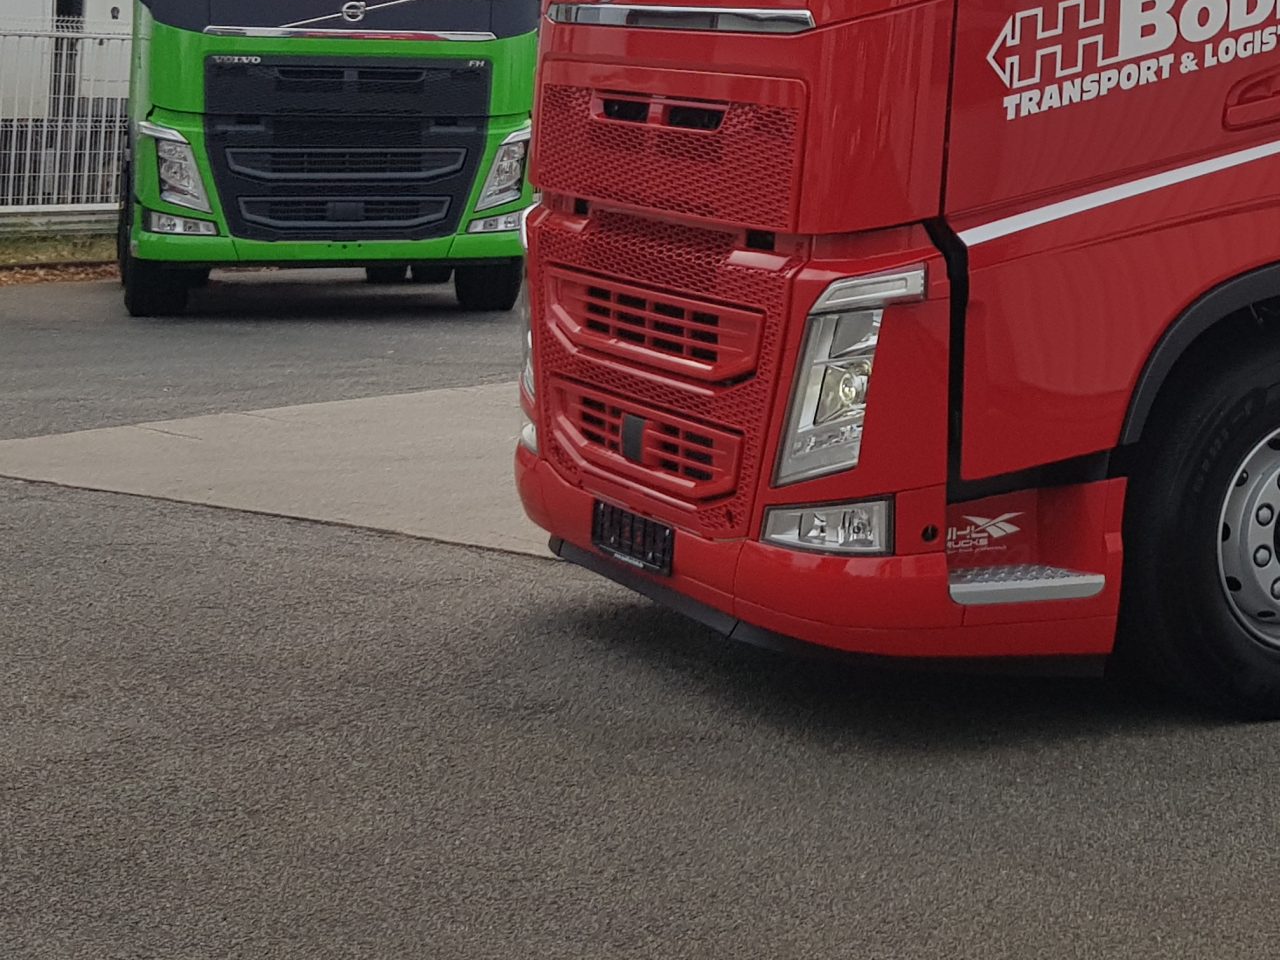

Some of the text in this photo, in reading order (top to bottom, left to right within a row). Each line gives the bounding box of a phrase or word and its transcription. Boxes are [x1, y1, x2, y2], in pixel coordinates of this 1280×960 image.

[211, 55, 262, 64] VOLVO
[468, 60, 485, 68] FH
[1003, 53, 1176, 121] TRANSPORT
[1179, 52, 1199, 74] &
